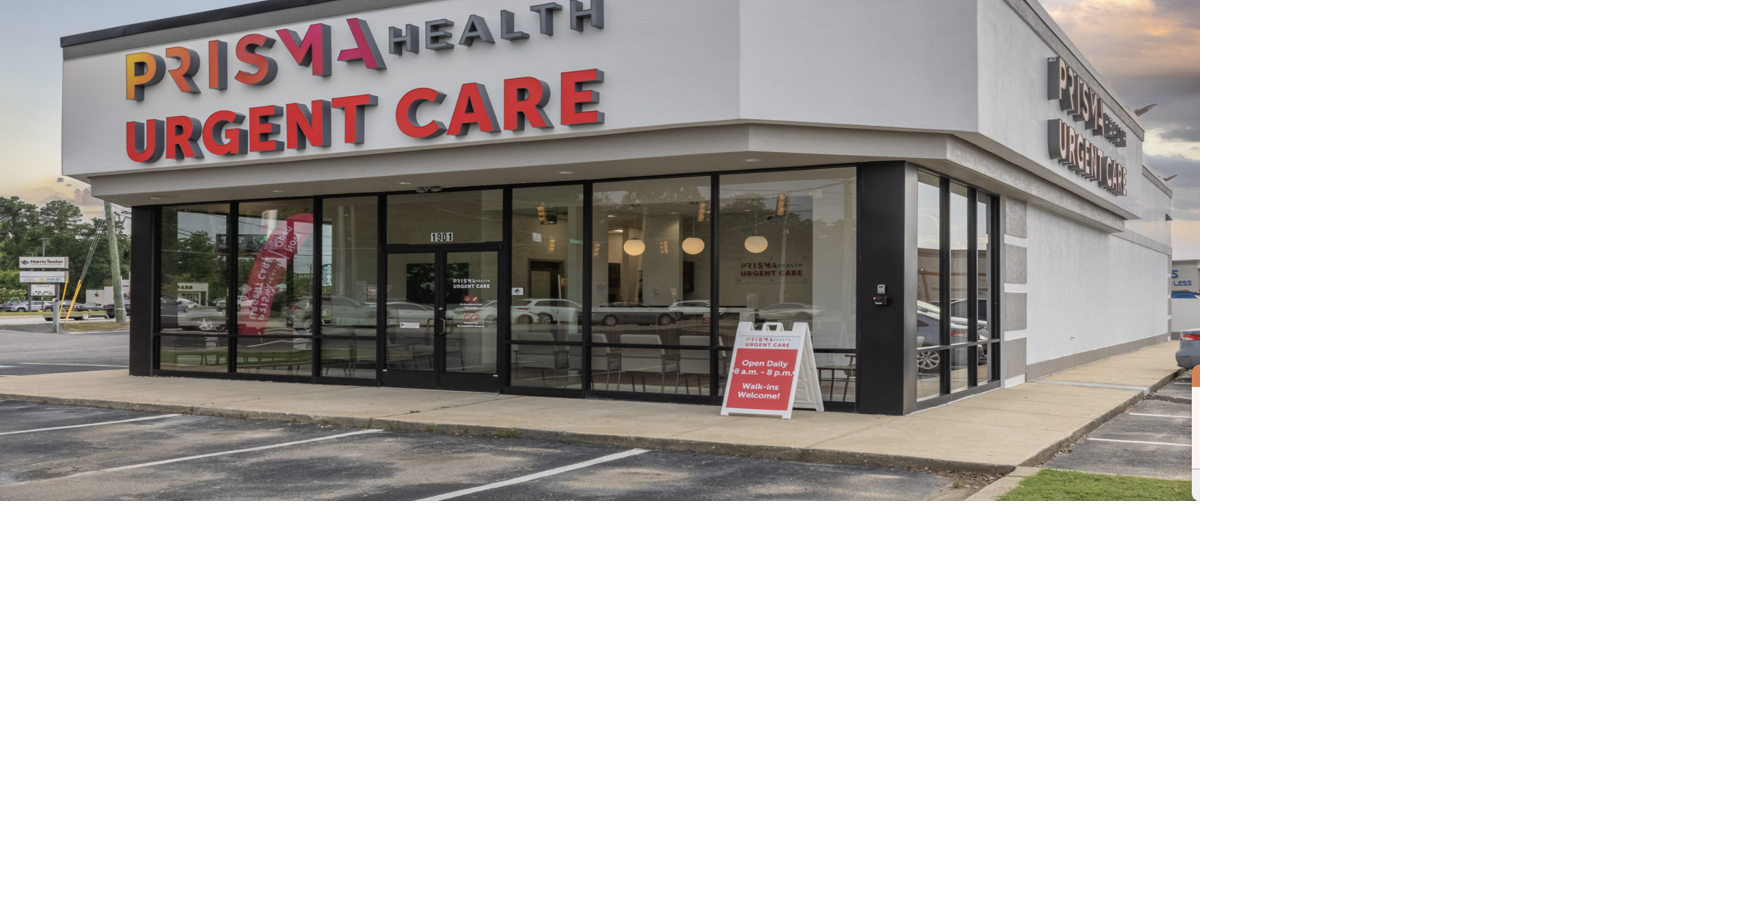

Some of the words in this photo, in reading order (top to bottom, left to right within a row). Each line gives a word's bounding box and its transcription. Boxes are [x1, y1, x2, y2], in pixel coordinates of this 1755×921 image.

[126, 17, 387, 102] PRISMA
[388, 0, 605, 57] HEALTH
[1048, 57, 1105, 136] PRISMA
[126, 93, 379, 163] URGENT
[395, 68, 605, 140] CARE
[1047, 118, 1104, 182] URGENT
[1099, 155, 1127, 196] CARE
[431, 232, 453, 242] 1901
[740, 262, 777, 270] PRISMA
[741, 359, 765, 368] Open
[767, 360, 788, 369] Daily
[766, 368, 773, 376] 8
[742, 382, 779, 391] Walk-ins
[738, 391, 781, 400] Welcome!
